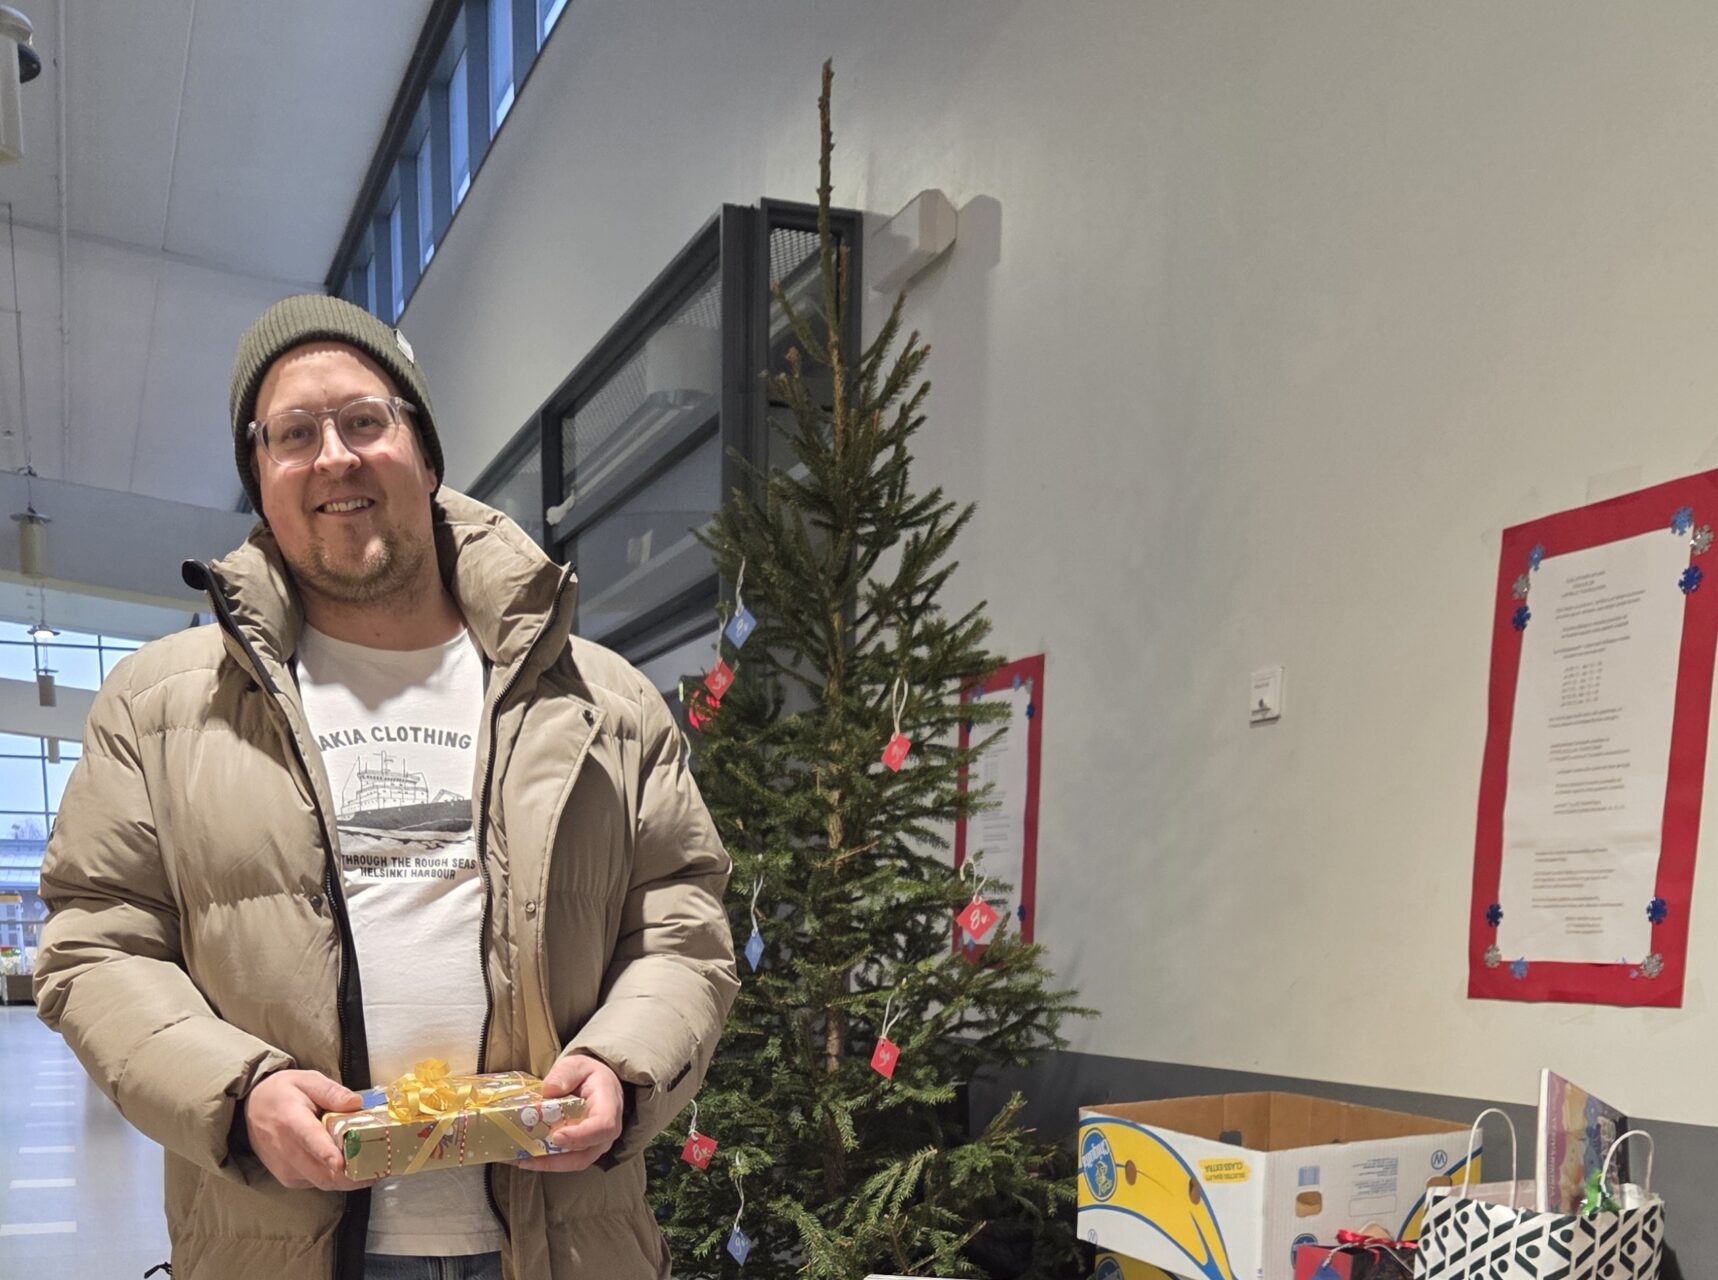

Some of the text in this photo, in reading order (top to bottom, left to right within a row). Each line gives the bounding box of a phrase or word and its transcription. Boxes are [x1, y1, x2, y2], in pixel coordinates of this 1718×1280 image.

[371, 726, 473, 750] CLOTHING
[341, 855, 476, 870] THROUGH THE ROUGH SEAS
[360, 867, 456, 880] HELSINKI HARBOUR
[1204, 1161, 1243, 1173] CLASS EXTRA
